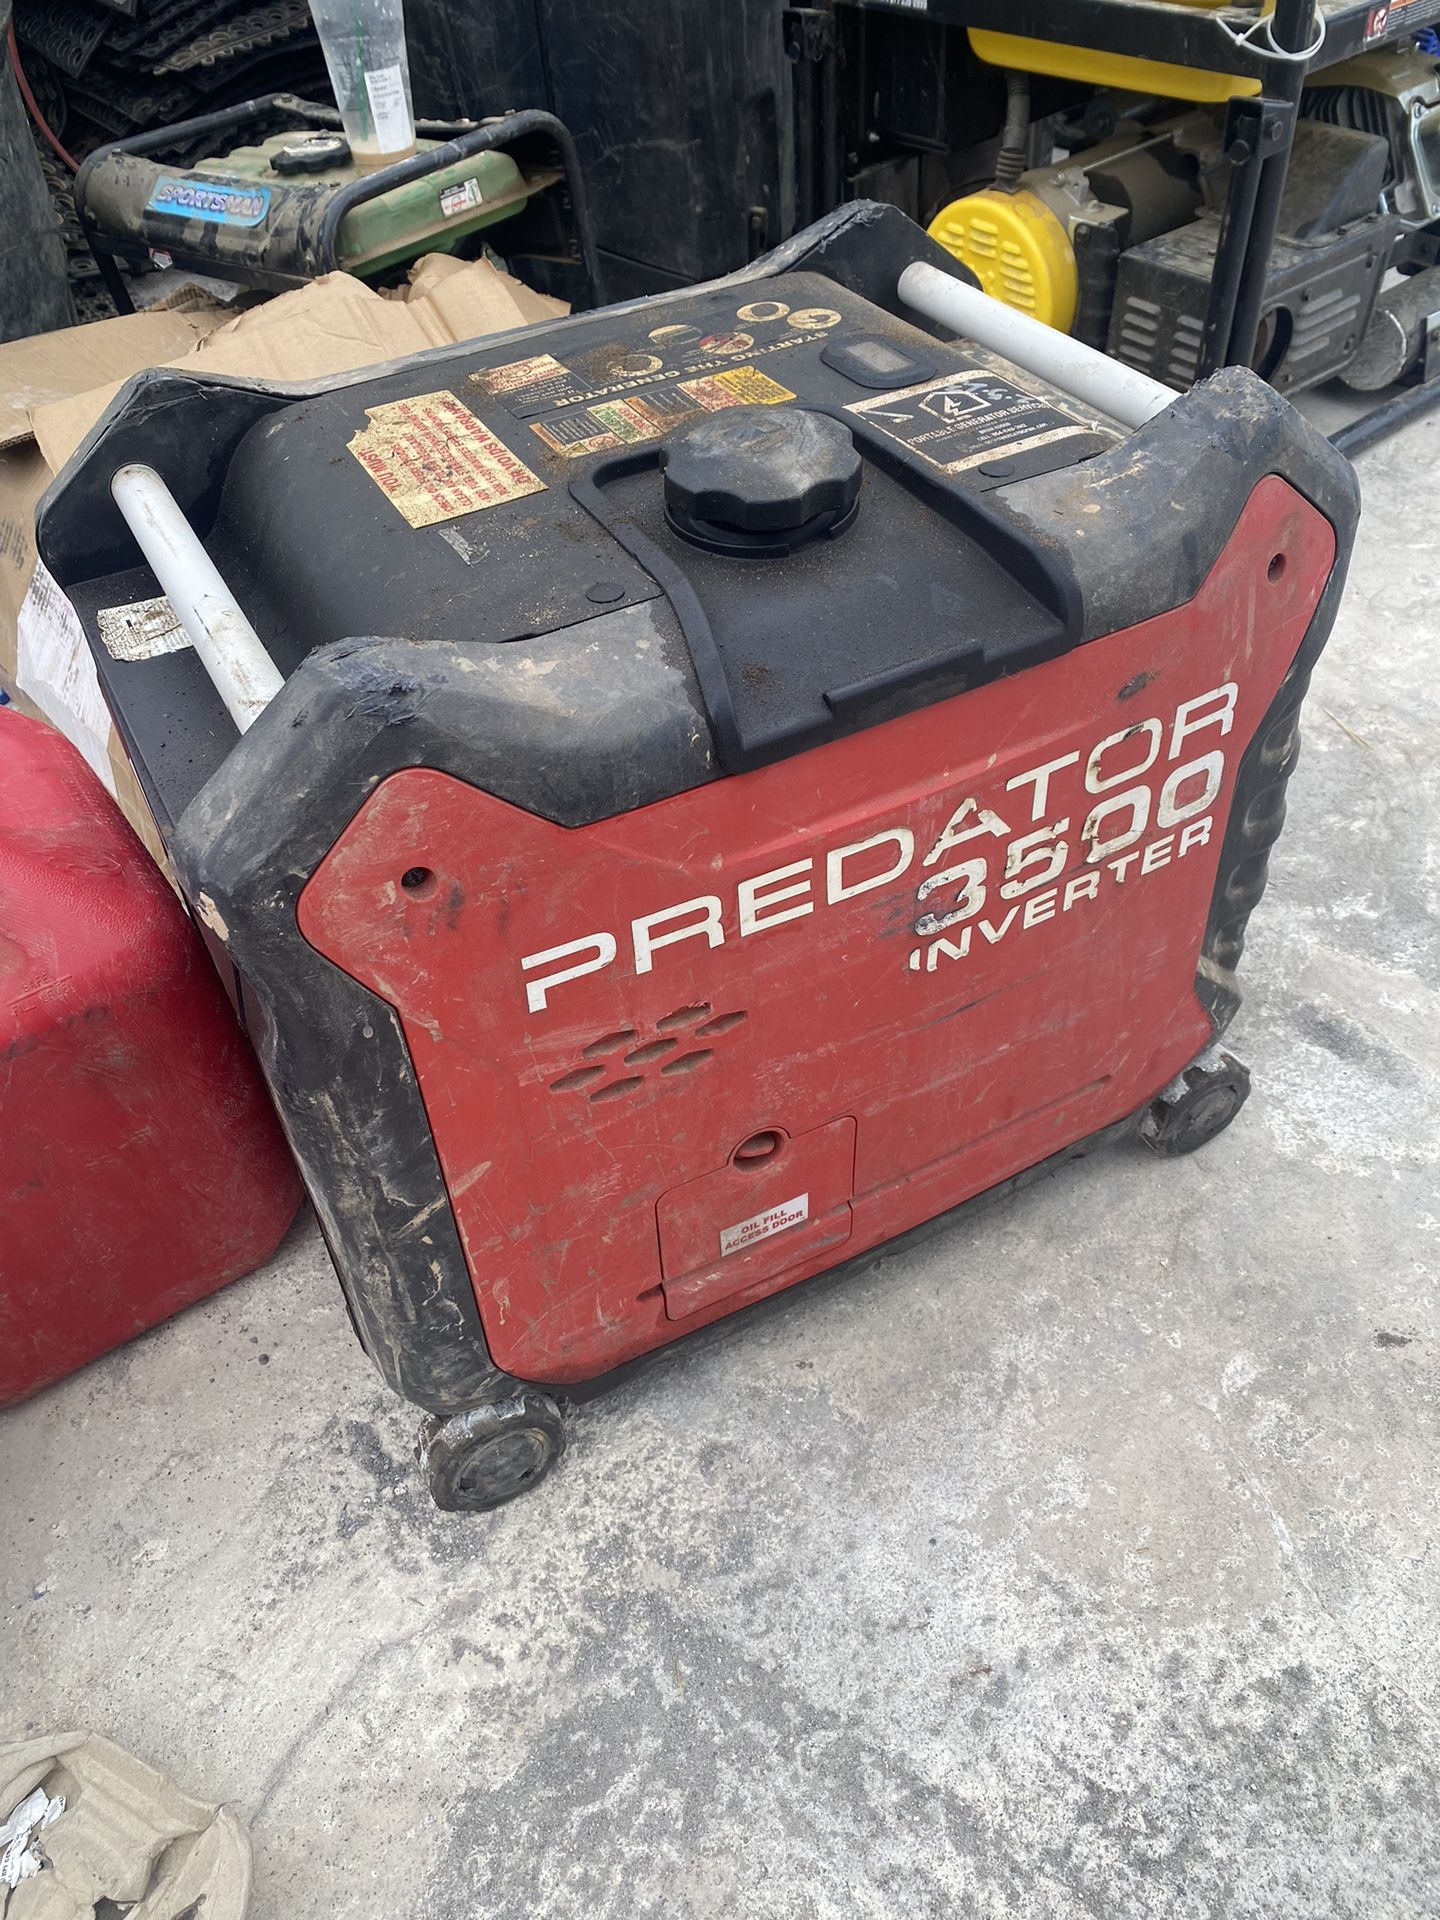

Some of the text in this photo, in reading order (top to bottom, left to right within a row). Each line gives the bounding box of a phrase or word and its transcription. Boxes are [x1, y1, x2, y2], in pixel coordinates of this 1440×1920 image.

[157, 185, 264, 216] SPORTSMAN
[733, 331, 830, 361] STARTING
[685, 358, 728, 373] THE
[554, 369, 680, 407] GENERATOR
[907, 426, 954, 446] PORTABLE
[952, 408, 1010, 434] GENERATOR
[483, 441, 517, 470] VOIDS
[378, 471, 402, 493] YOU
[508, 468, 532, 484] OR
[521, 682, 1240, 1014] PREDATOR
[914, 750, 1225, 936] 3500
[909, 816, 1212, 972] INVERTER
[724, 1210, 804, 1250] ACCESS DOOR
[741, 1209, 788, 1235] OIL FILL
